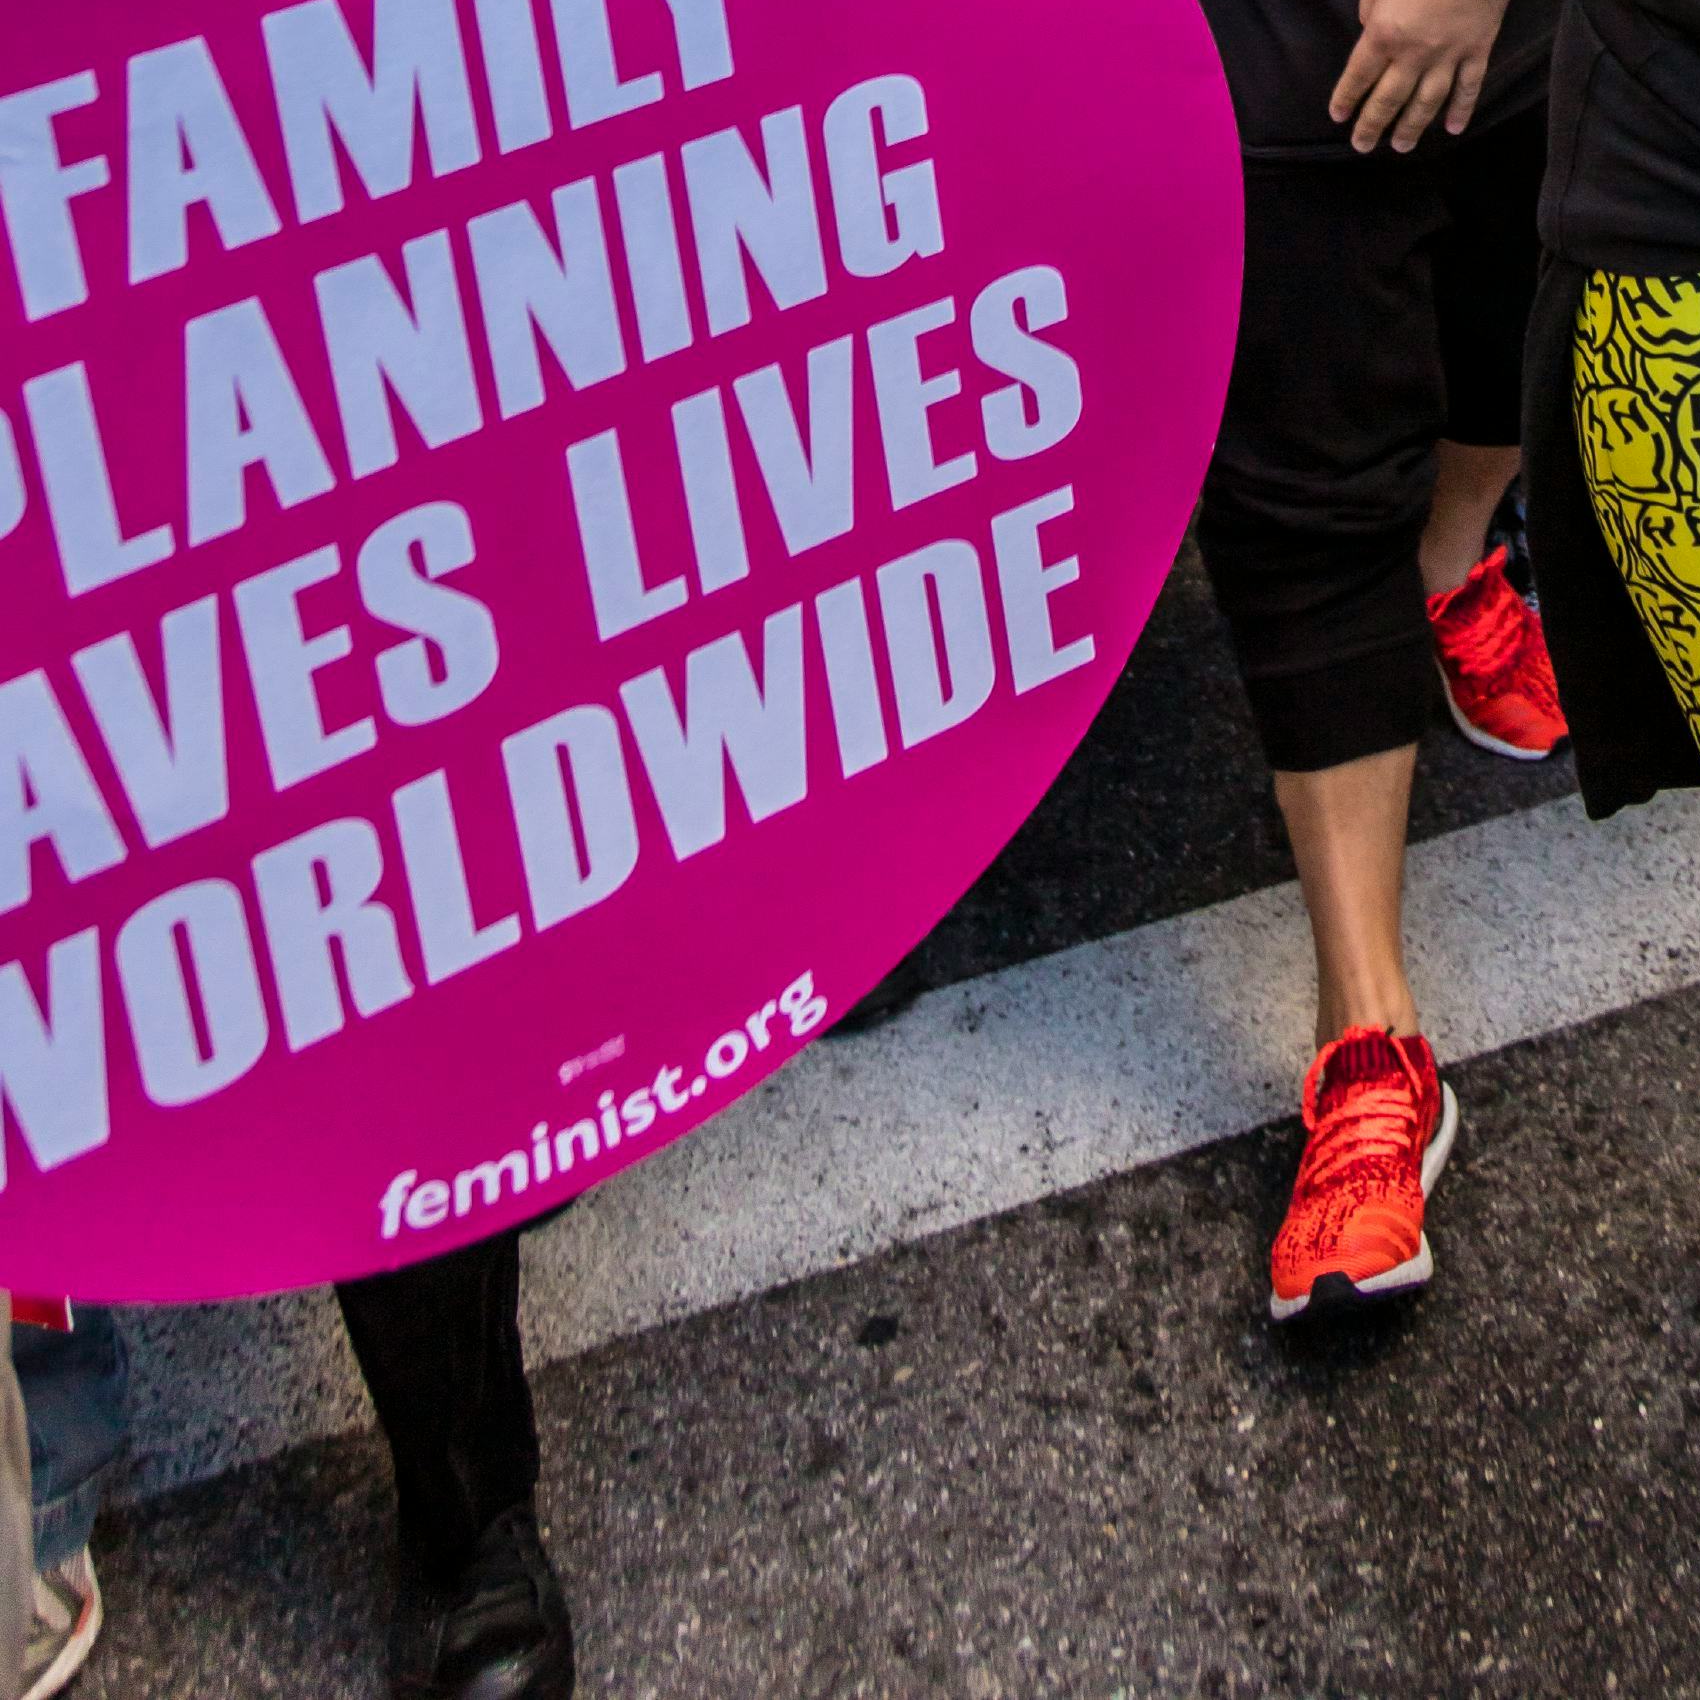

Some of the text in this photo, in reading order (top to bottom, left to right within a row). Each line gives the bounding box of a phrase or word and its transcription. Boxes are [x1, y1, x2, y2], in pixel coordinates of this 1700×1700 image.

[0, 264, 1084, 912] AVES LIVES
[379, 968, 830, 1241] feminist.org
